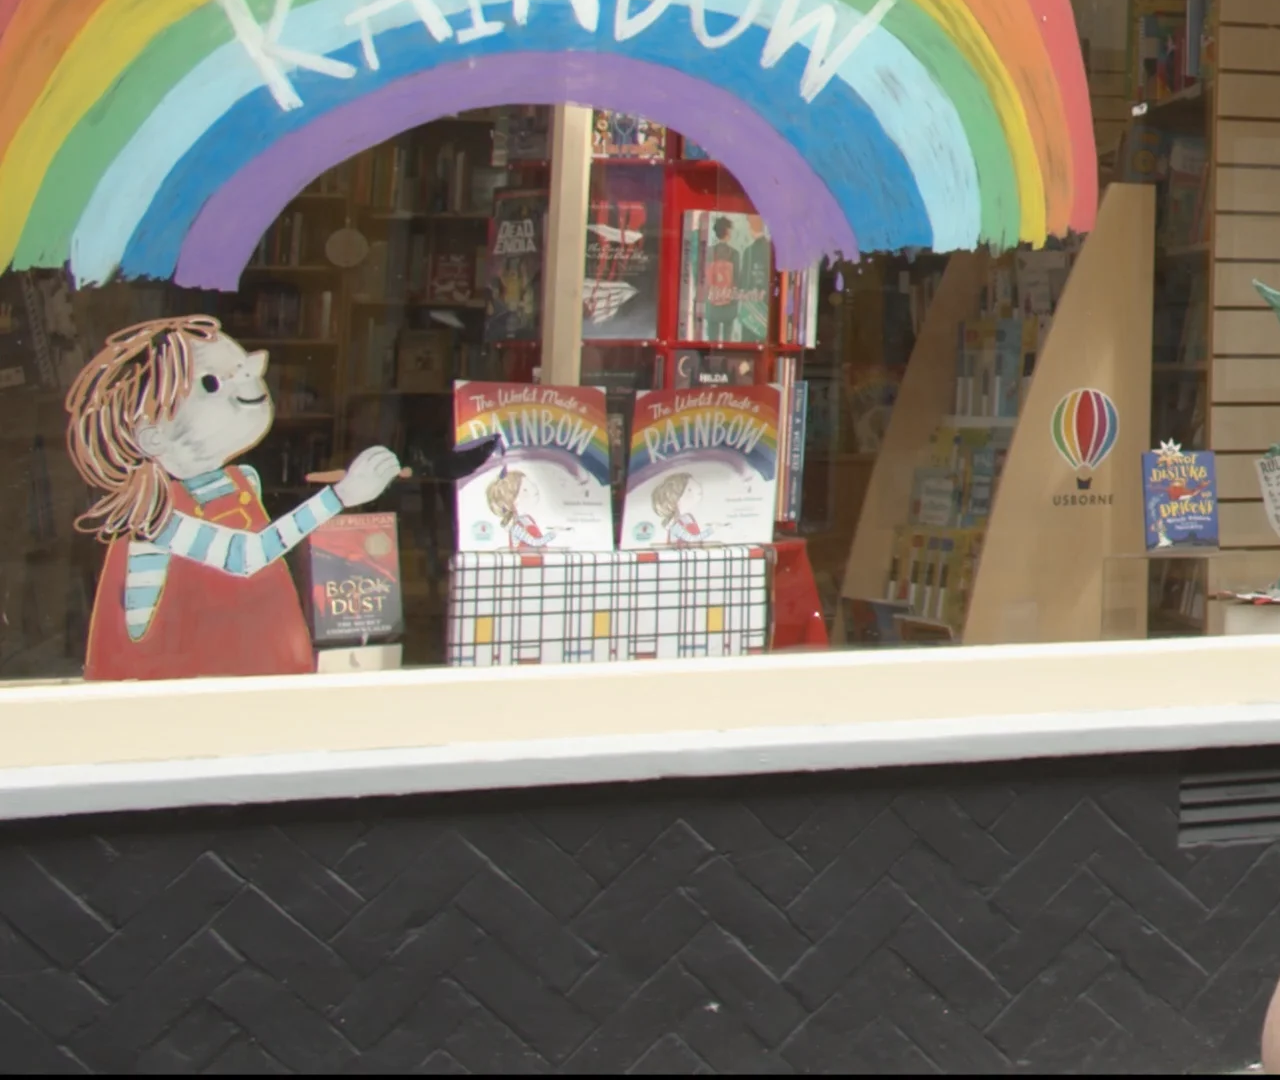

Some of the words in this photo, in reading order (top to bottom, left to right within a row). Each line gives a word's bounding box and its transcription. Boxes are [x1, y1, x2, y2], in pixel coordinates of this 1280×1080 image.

[469, 394, 494, 412] The
[648, 402, 672, 420] The
[643, 411, 769, 464] RAINBOW
[1052, 494, 1115, 506] USBORNE
[326, 578, 391, 598] BOOK
[331, 595, 386, 615] DUST
